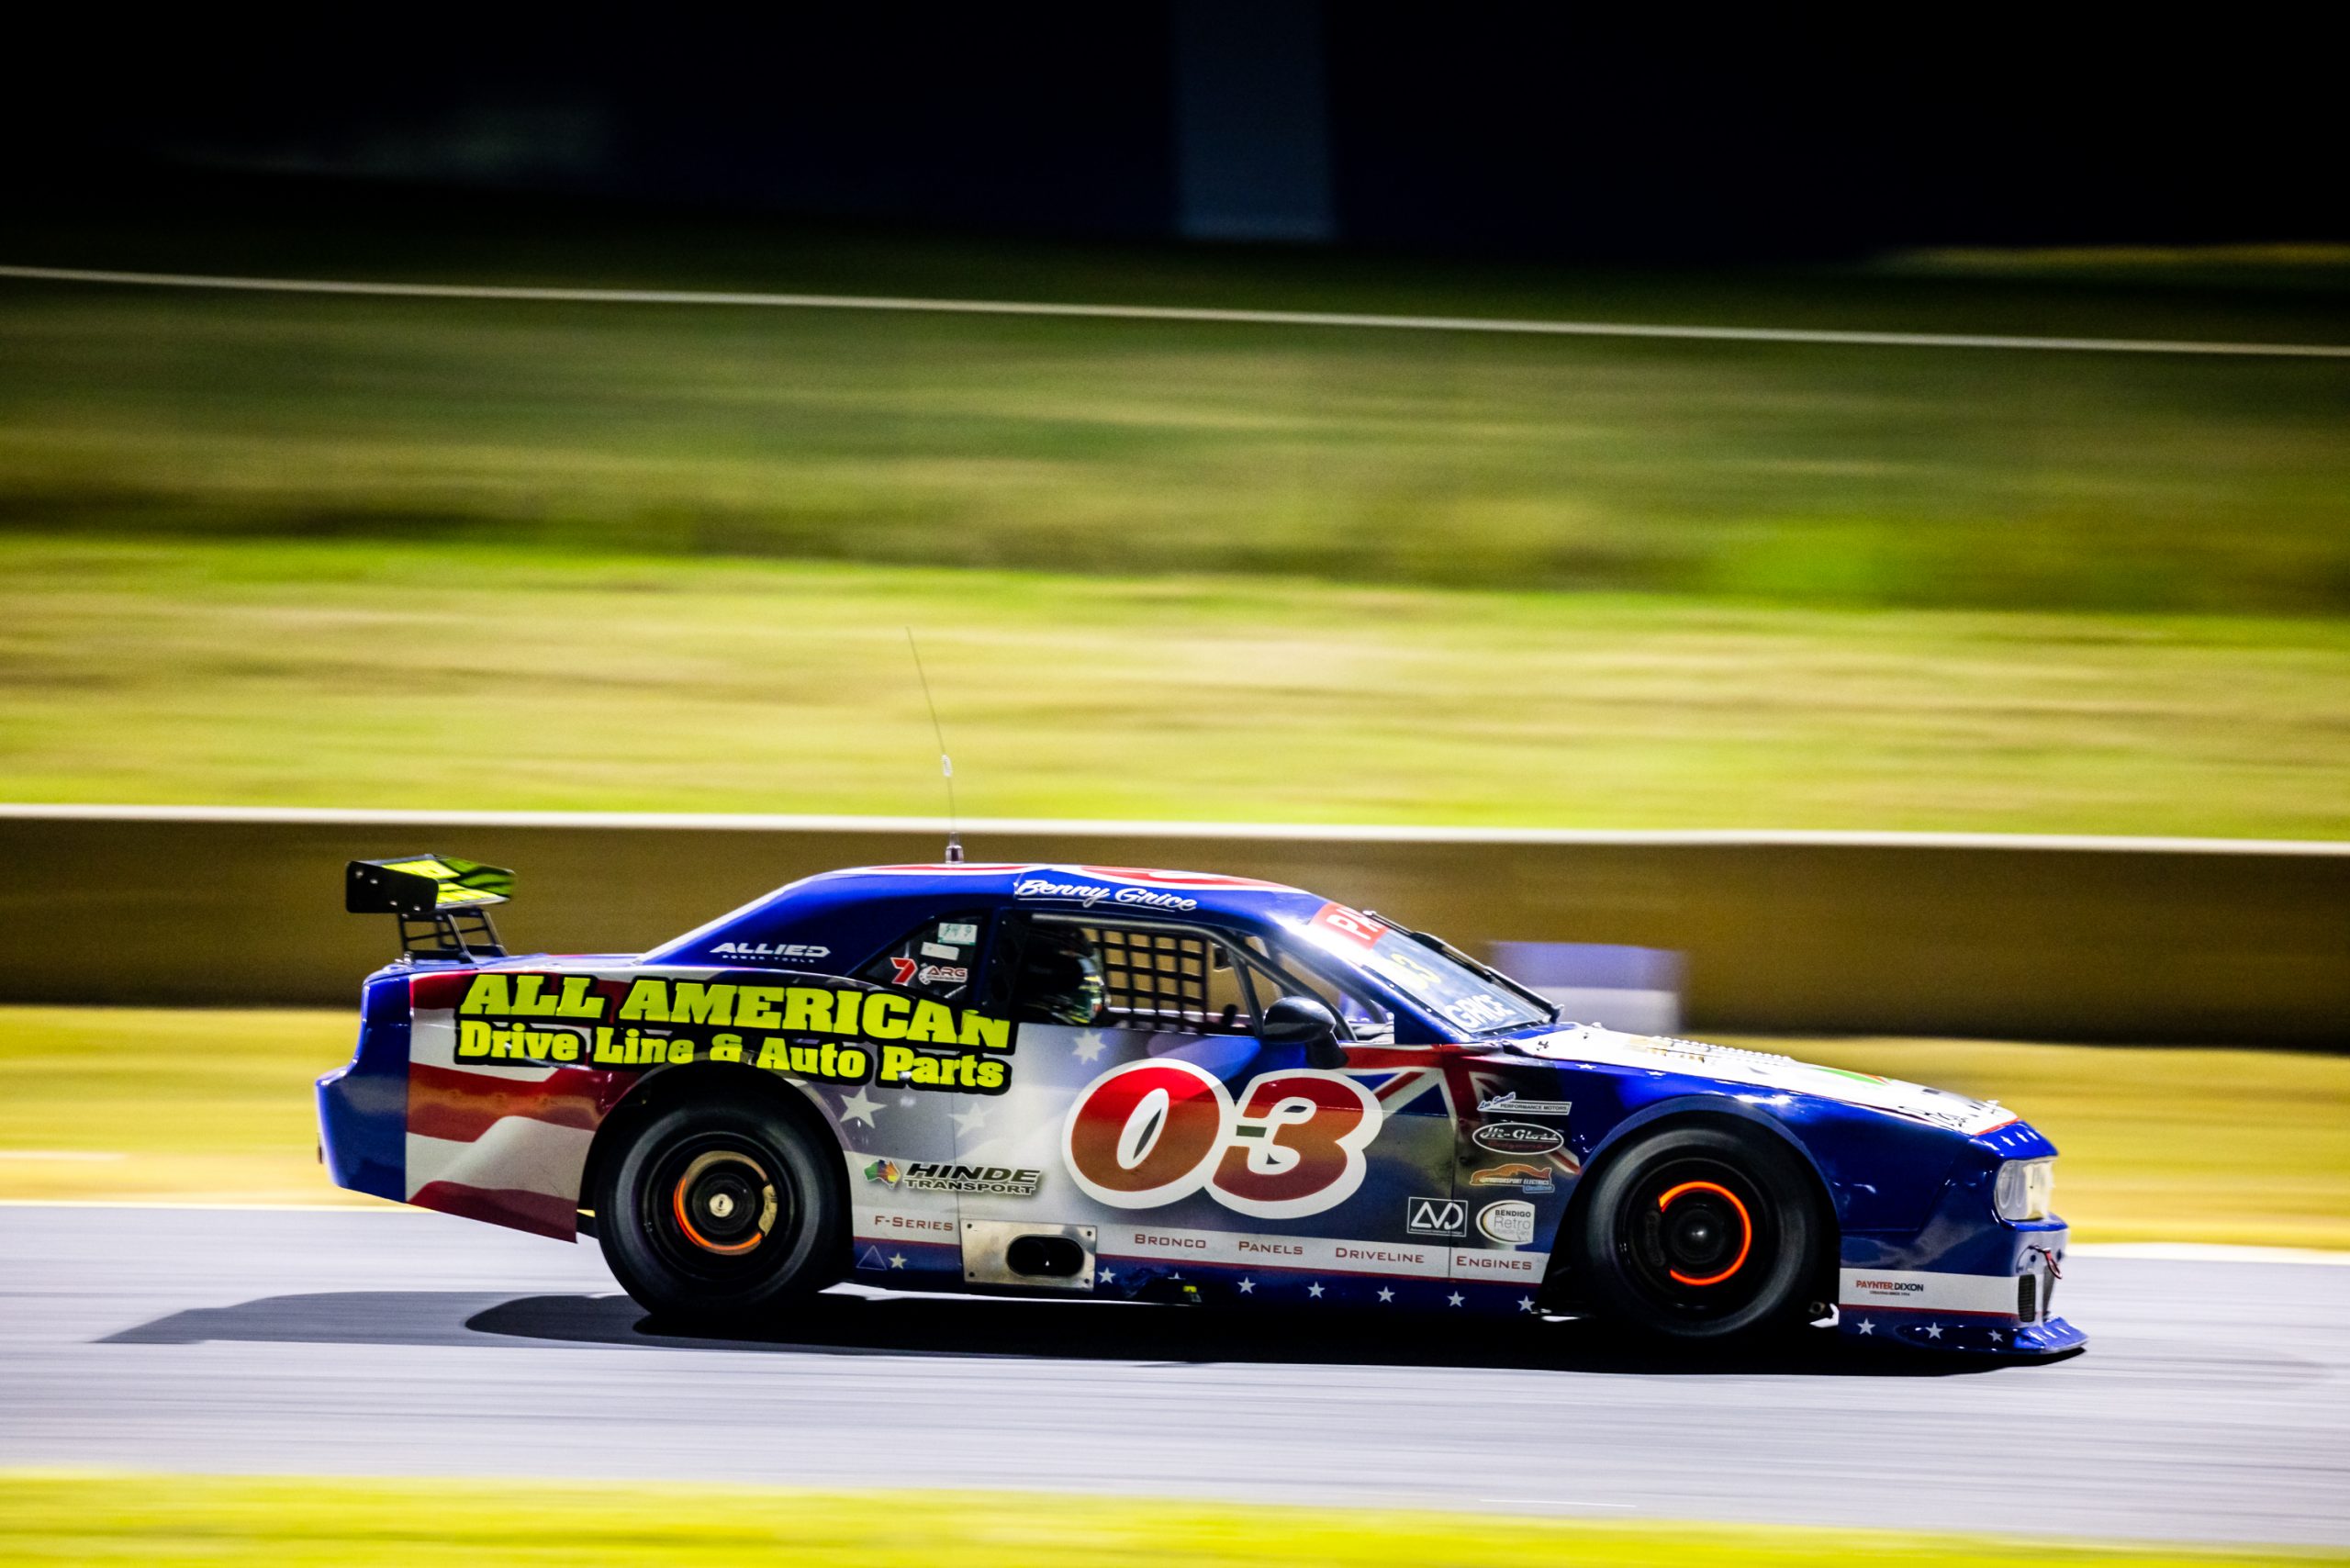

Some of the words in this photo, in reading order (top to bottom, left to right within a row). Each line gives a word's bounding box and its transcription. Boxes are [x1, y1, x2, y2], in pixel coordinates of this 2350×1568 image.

[1016, 879, 1110, 908] Benny
[1114, 888, 1197, 911] Grice
[710, 943, 831, 958] ALLIED
[926, 966, 968, 978] ARG
[459, 974, 605, 1018] ALL
[619, 980, 1011, 1048] AMERICAN
[1445, 993, 1516, 1029] GRICE
[458, 1020, 580, 1061] Drive
[593, 1026, 696, 1064] Line
[709, 1033, 744, 1063] &
[756, 1036, 867, 1078] Auto
[880, 1045, 1005, 1088] Parts
[1061, 1058, 1382, 1219] 03
[905, 1162, 1041, 1183] HINDE
[904, 1179, 1035, 1194] TRANSPORT
[1494, 1209, 1532, 1218] BENDIGO
[1494, 1215, 1532, 1230] Retro
[1856, 1280, 1893, 1290] PAYNTER
[1894, 1282, 1924, 1292] DIXON
